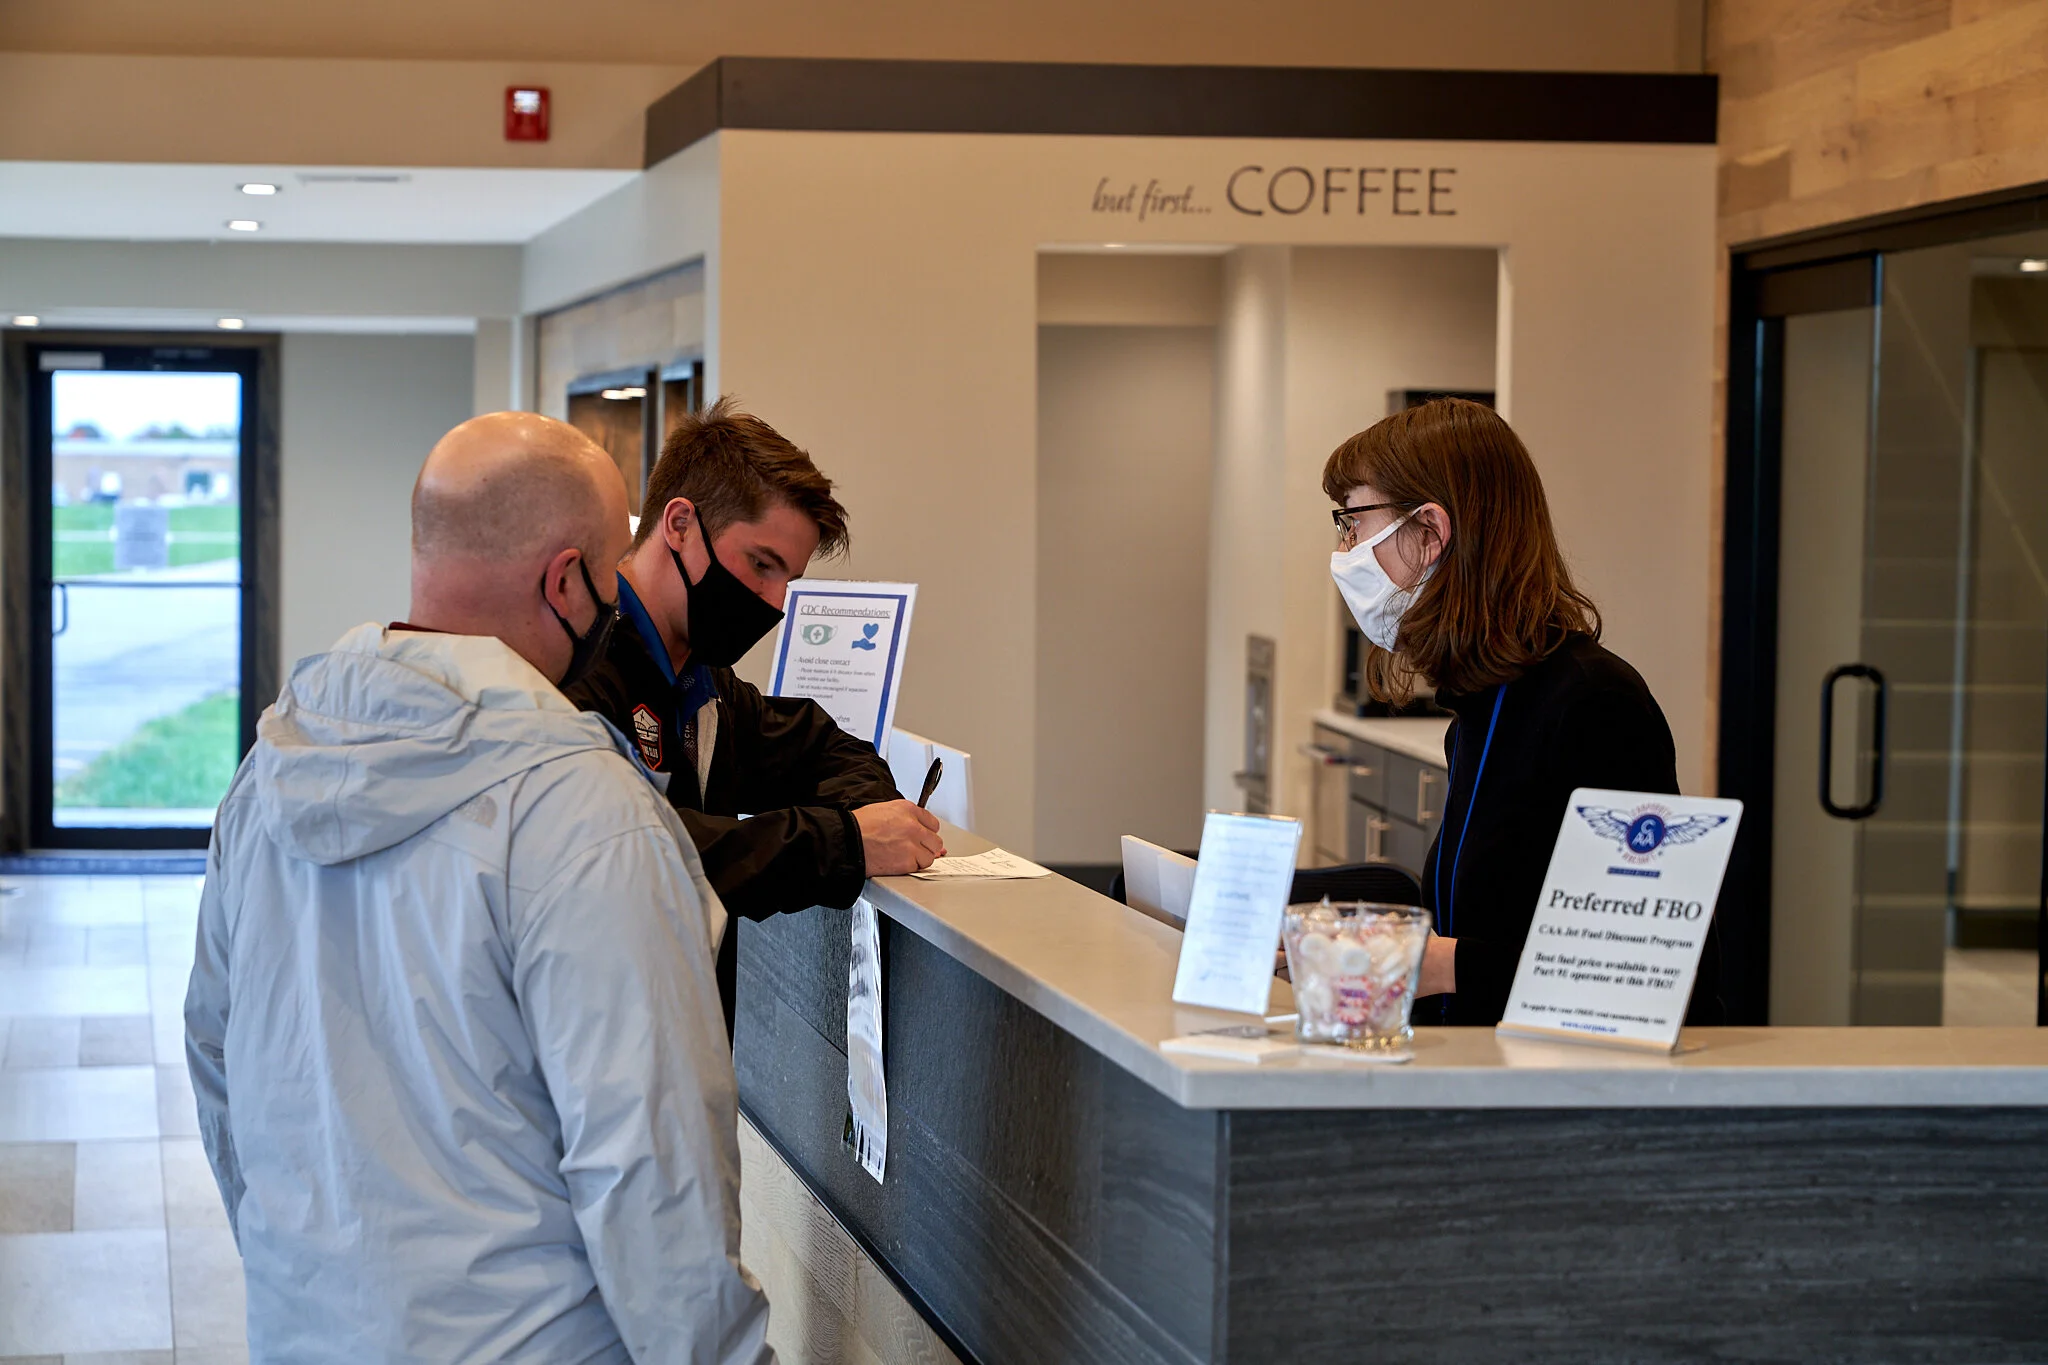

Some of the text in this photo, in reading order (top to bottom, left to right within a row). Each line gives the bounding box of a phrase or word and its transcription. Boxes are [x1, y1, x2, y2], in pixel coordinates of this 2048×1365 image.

[1091, 177, 1135, 213] but
[1226, 165, 1457, 216] COFFEE
[800, 604, 890, 618] CDC Recommendations:
[1548, 889, 1703, 922] Preferred FBO
[1564, 926, 1580, 938] Jet
[1581, 928, 1602, 939] Fuel
[1605, 930, 1648, 944] Discount
[1650, 935, 1694, 949] Program
[1533, 966, 1555, 976] Part
[1570, 971, 1612, 984] operator
[1614, 976, 1624, 984] at
[1627, 976, 1644, 986] this
[1535, 952, 1556, 962] Best
[1558, 953, 1576, 965] fuel
[1577, 956, 1602, 968] price
[1605, 959, 1648, 973] available
[1663, 967, 1681, 978] any
